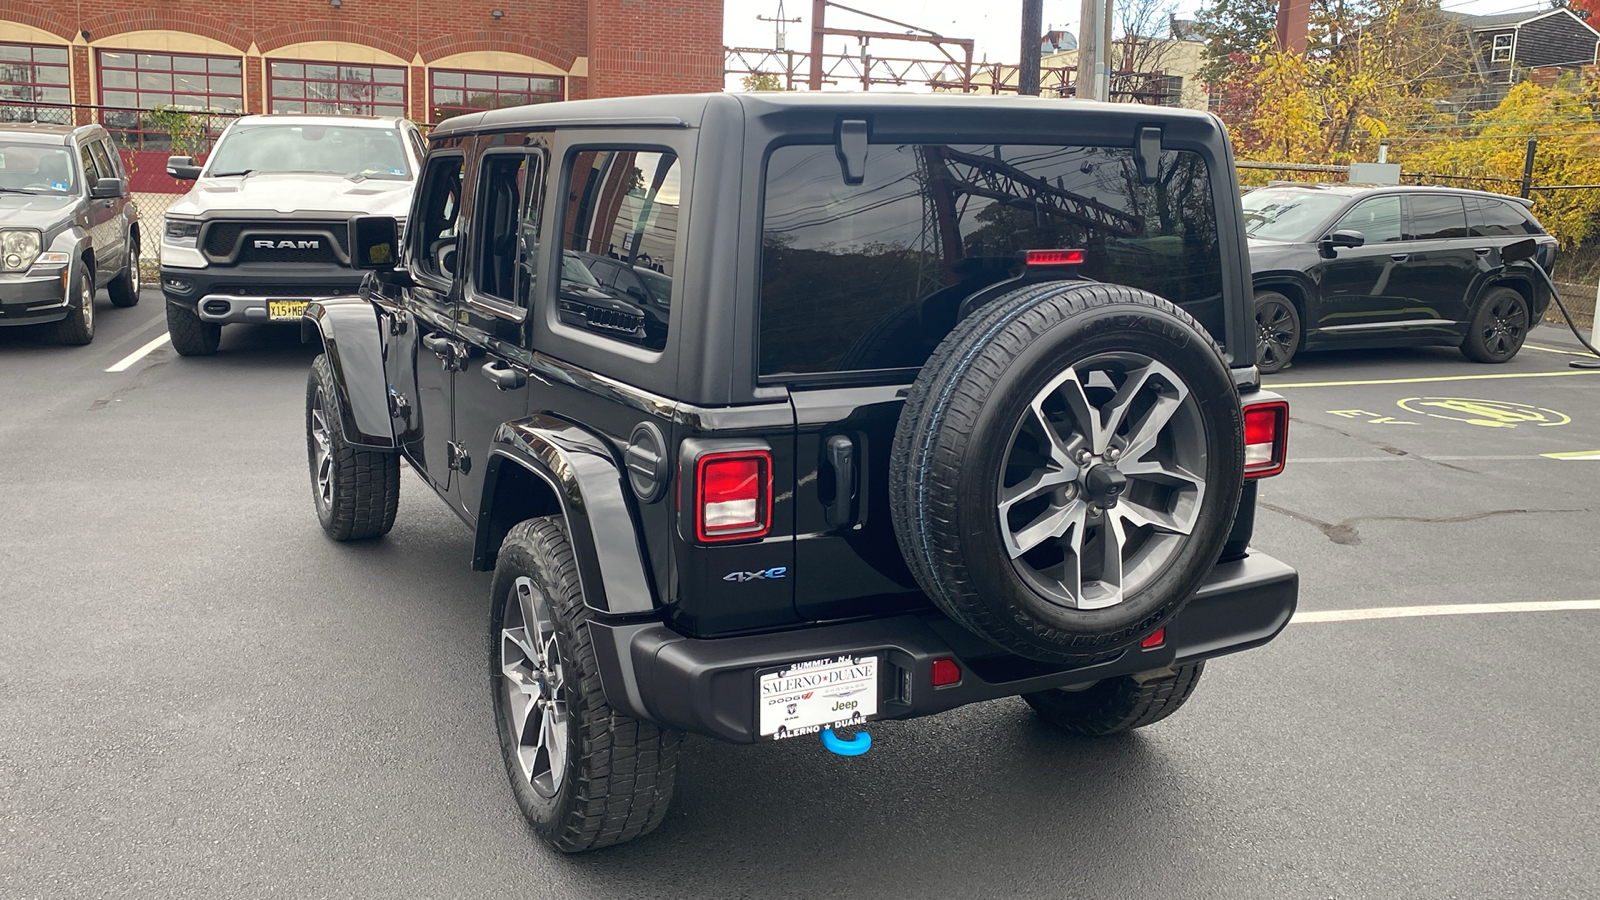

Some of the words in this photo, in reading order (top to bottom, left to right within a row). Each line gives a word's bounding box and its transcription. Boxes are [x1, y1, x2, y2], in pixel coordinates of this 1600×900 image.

[254, 240, 319, 249] RAM
[1094, 315, 1178, 339] NEXEN
[838, 655, 851, 663] NJ
[763, 674, 822, 695] SALERNO
[829, 665, 873, 683] DUANE
[831, 700, 858, 712] Jeep
[773, 724, 820, 741] SALERNO
[834, 715, 867, 729] DUANE
